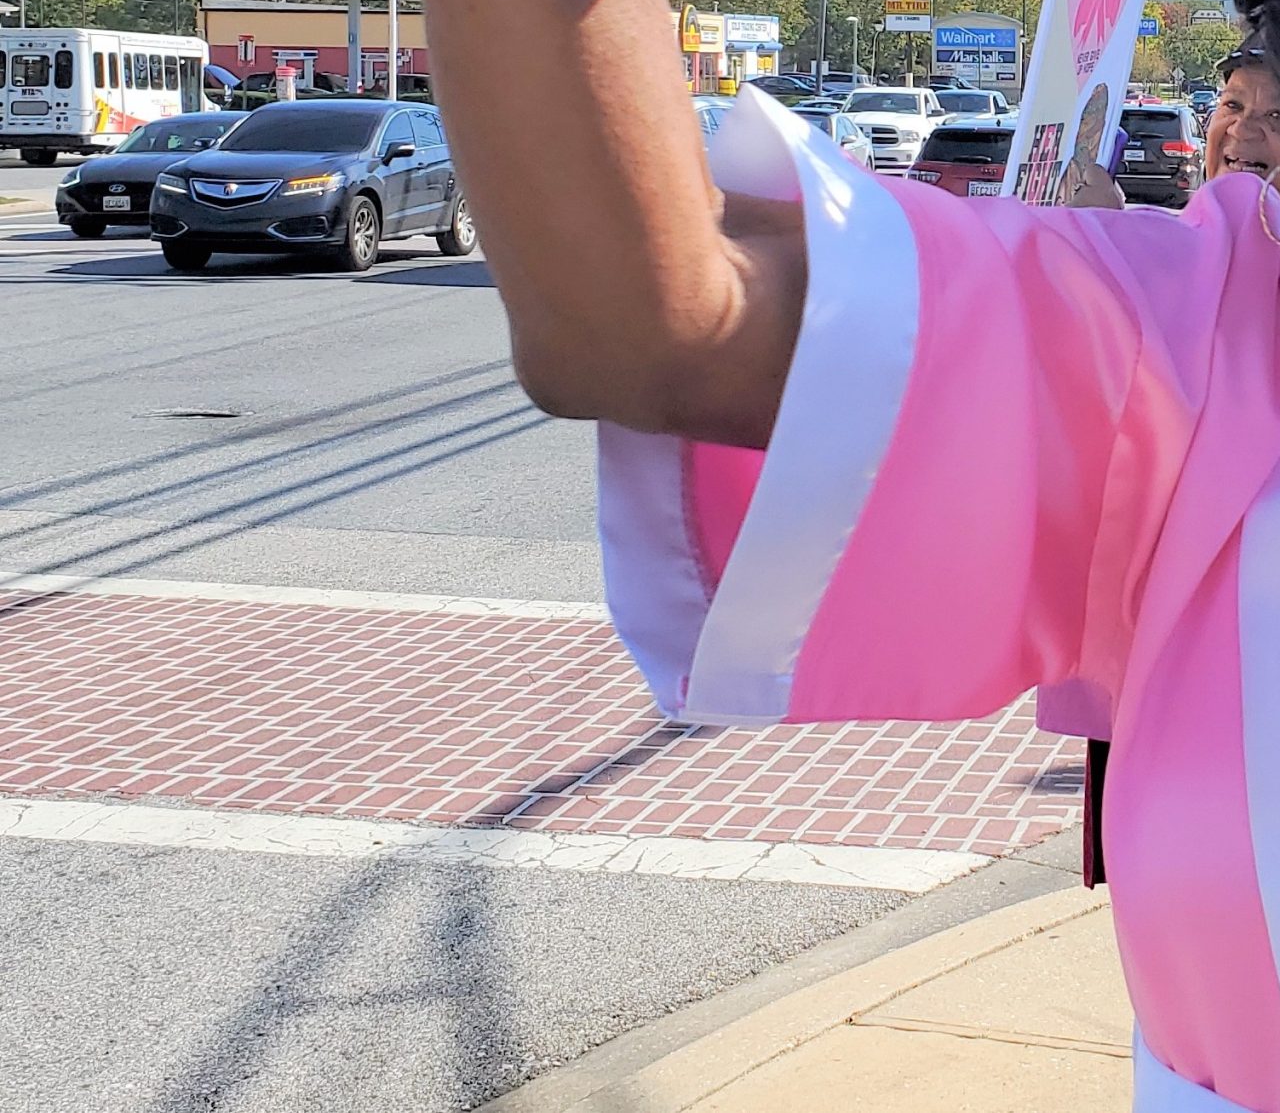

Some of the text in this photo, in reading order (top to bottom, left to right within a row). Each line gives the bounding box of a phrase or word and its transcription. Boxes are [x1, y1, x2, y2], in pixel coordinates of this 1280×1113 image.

[906, 1, 929, 10] TIRE
[941, 31, 996, 44] Walmart
[949, 50, 1004, 63] Marshalls
[1012, 160, 1063, 201] FIGHT
